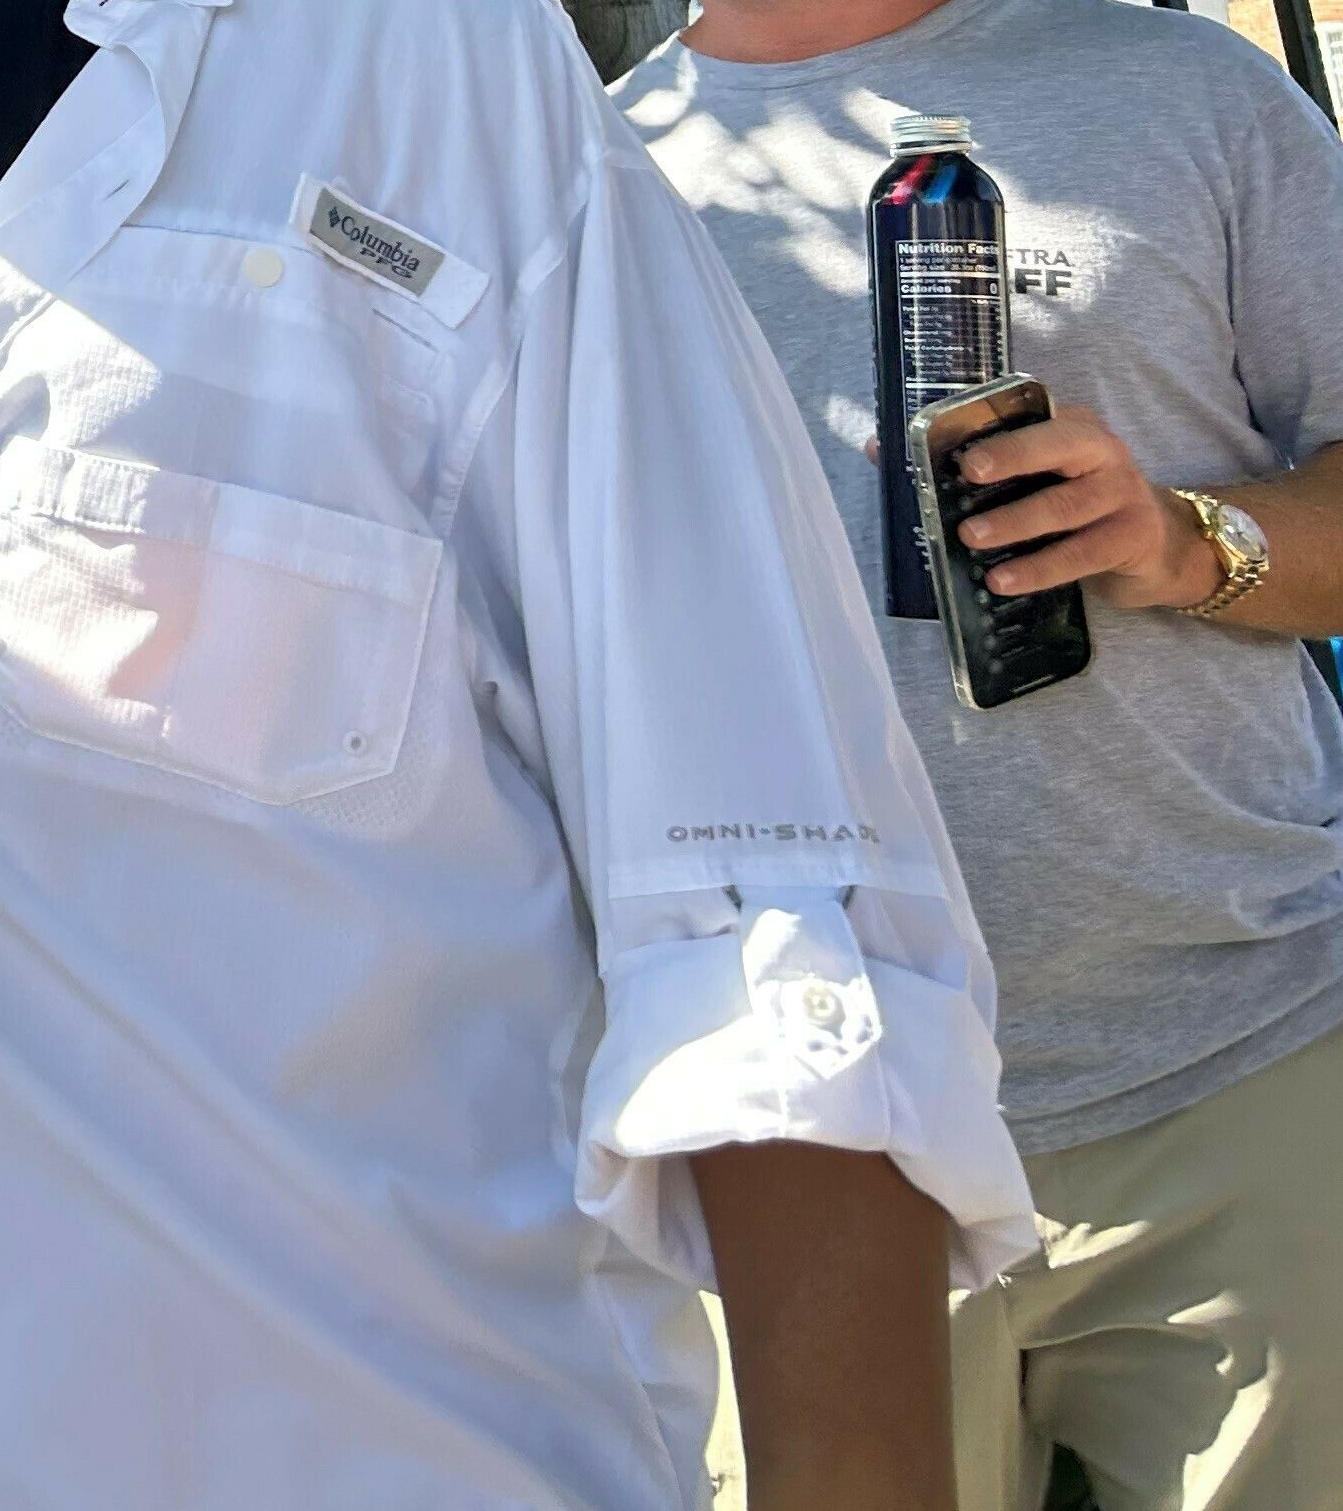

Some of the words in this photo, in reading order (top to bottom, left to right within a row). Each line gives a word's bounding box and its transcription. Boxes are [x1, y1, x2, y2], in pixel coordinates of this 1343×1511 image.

[340, 215, 421, 272] Columbia
[898, 242, 964, 255] Nutrition
[900, 284, 952, 294] Calories
[989, 282, 998, 295] 0
[1005, 267, 1072, 296] FF
